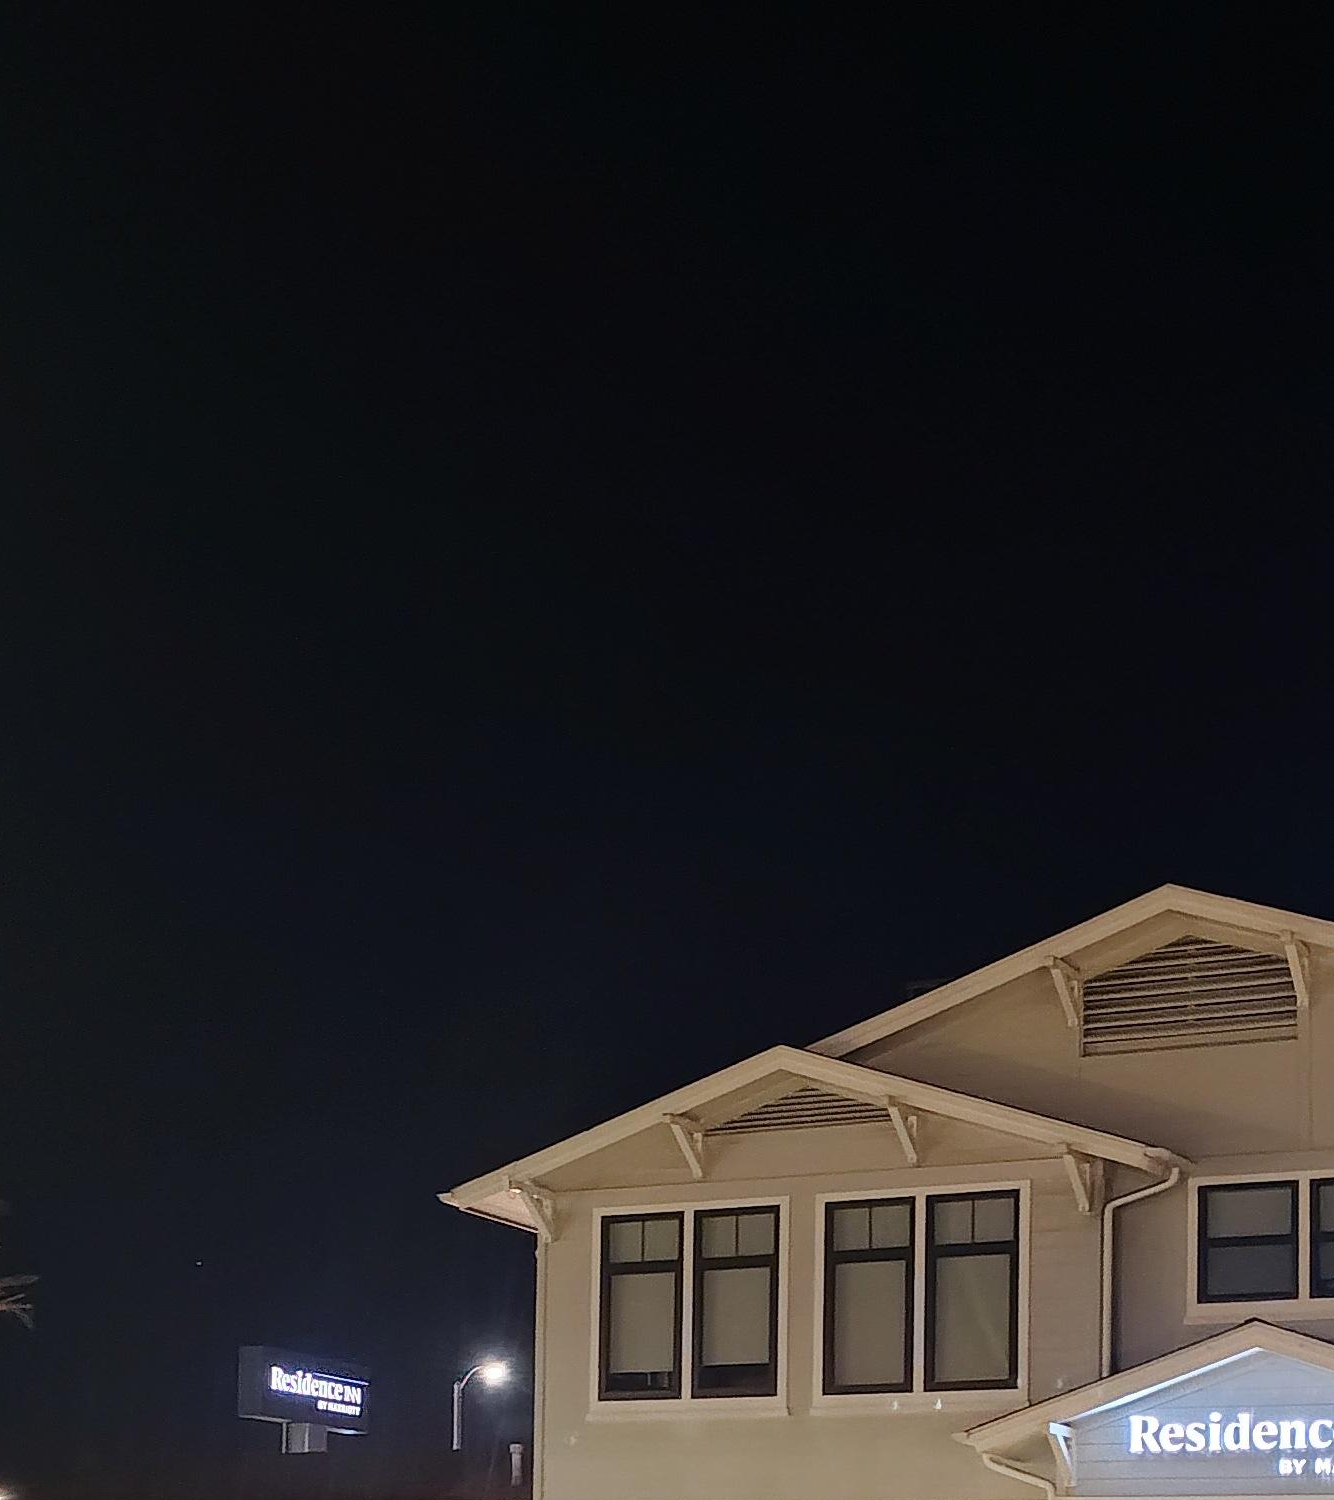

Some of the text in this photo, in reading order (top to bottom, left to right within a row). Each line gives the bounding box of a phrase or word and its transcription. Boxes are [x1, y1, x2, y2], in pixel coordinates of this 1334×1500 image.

[270, 1365, 362, 1405] Residence INN
[1278, 1456, 1306, 1475] BY
